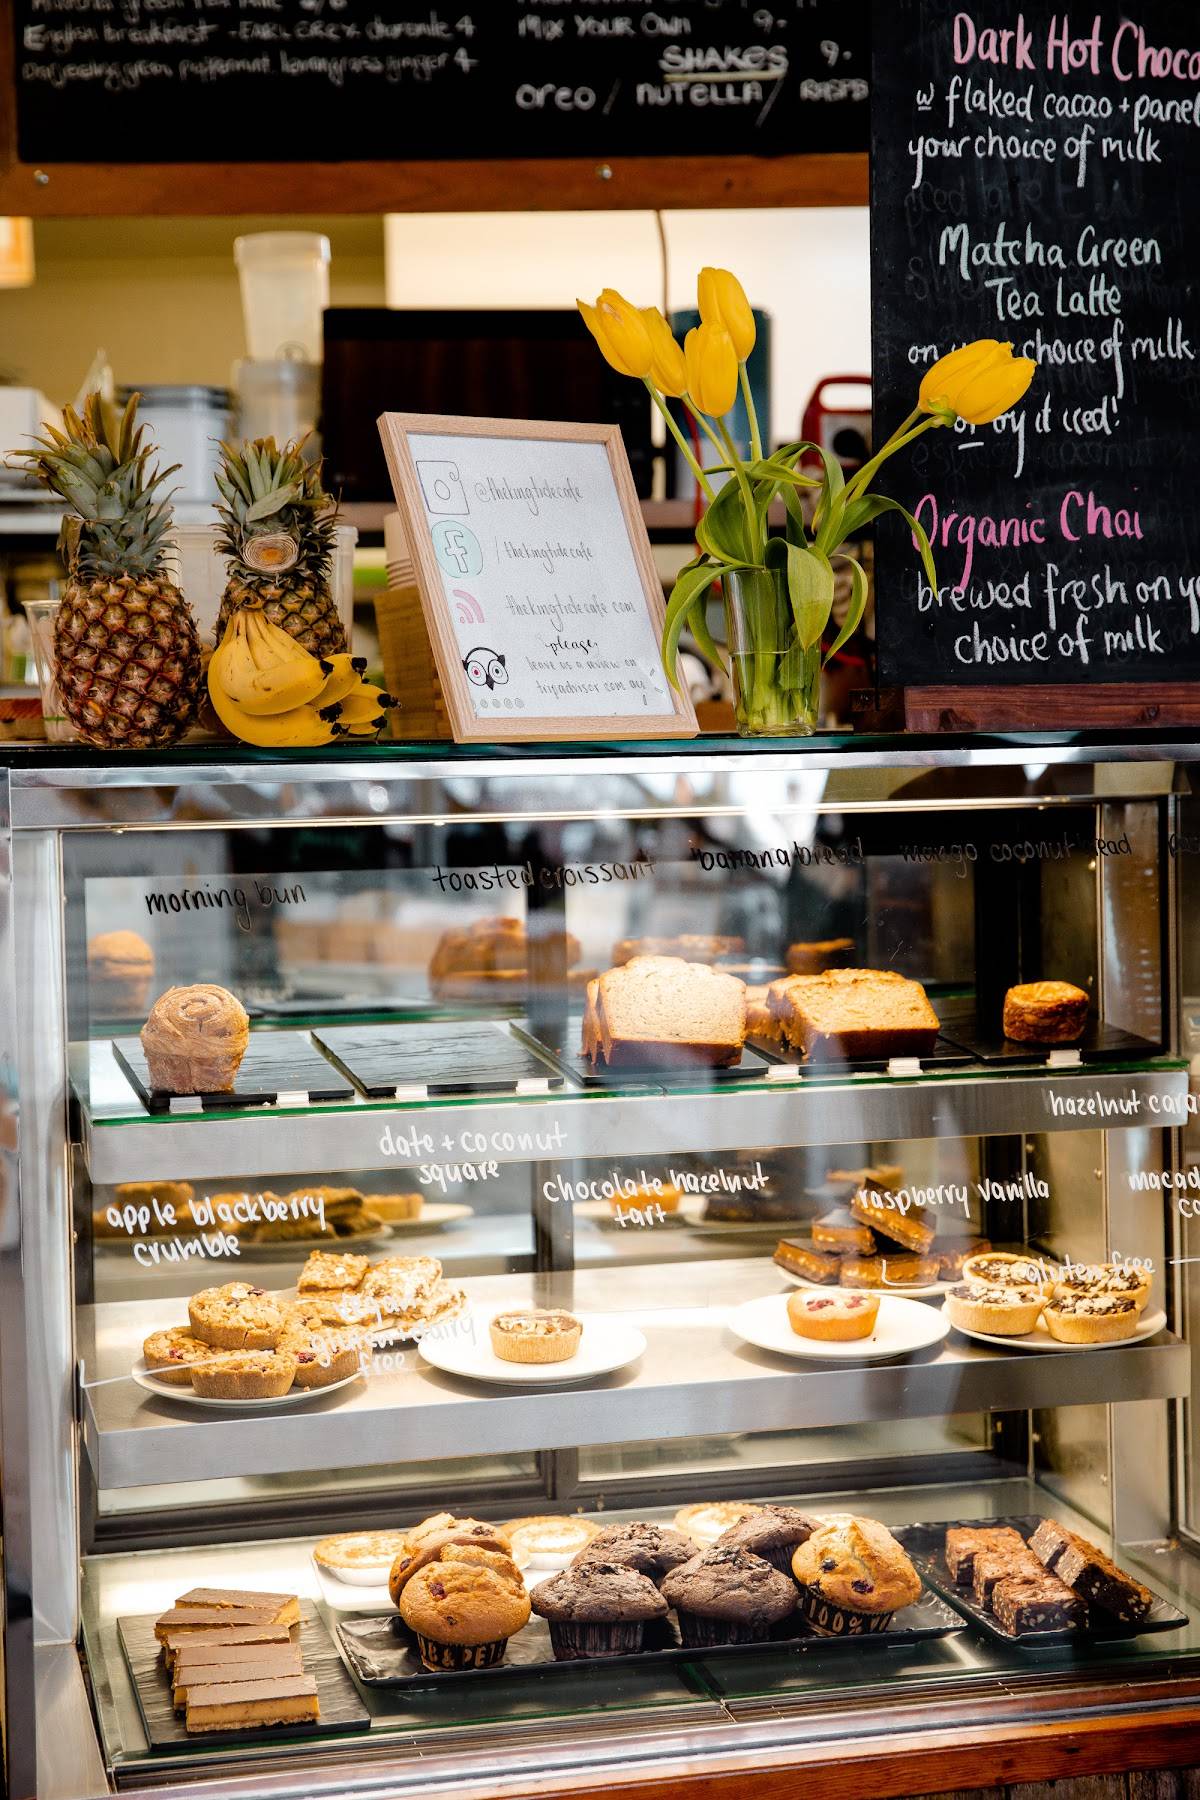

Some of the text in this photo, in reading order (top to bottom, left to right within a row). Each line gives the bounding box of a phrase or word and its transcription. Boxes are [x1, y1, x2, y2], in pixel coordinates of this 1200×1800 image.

[953, 12, 1200, 81] Dark Hot Choco
[945, 75, 1034, 128] flaked
[1043, 93, 1113, 119] cacao
[908, 124, 1162, 189] your choice of milk
[939, 221, 1067, 281] Matcha
[1076, 225, 1162, 269] Green
[984, 277, 1044, 321] Tea
[1056, 272, 1122, 317] Latte
[907, 316, 1196, 400] on choice of milk
[911, 488, 1144, 593] Organic Chai
[917, 571, 1033, 612] brewed
[1043, 563, 1128, 630] fresh
[1136, 575, 1172, 603] on
[954, 613, 1165, 664] choice of milk
[432, 860, 656, 892] toasted croissant
[689, 836, 866, 871] banana bread
[145, 881, 306, 932] morning bun
[1049, 1088, 1141, 1117] hazelnut
[380, 1125, 435, 1158] date
[460, 1121, 568, 1153] coconut
[419, 1159, 500, 1193] square
[543, 1162, 769, 1203] chocolate hazelnut
[859, 1171, 1050, 1218] raspberry vanilla
[106, 1194, 327, 1234] apple blackberry
[614, 1203, 666, 1227] tart
[133, 1231, 241, 1267] crumble
